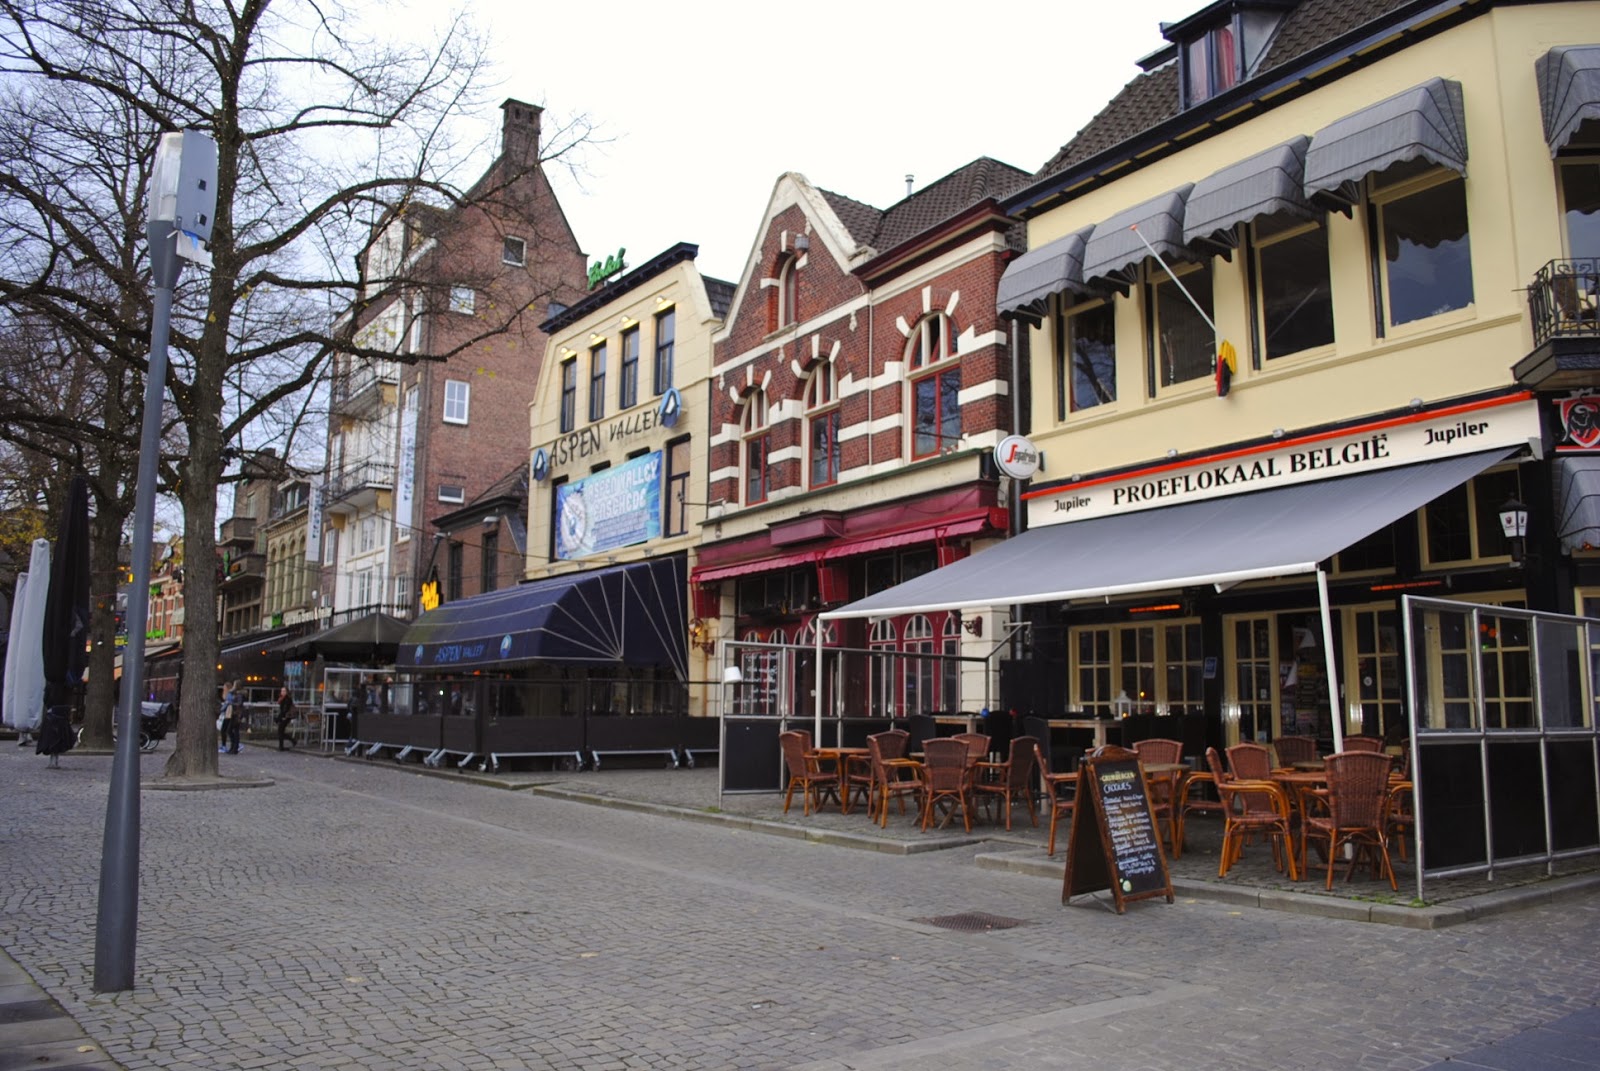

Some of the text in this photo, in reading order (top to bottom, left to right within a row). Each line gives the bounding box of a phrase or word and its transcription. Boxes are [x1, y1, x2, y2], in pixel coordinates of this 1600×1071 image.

[549, 405, 661, 467] ASPEN VALLEY
[1423, 421, 1489, 445] Jupiler
[1112, 433, 1390, 505] PROEFLOKAAL BELGIË
[1053, 496, 1091, 512] Jupiler
[435, 645, 462, 662] ASPEN
